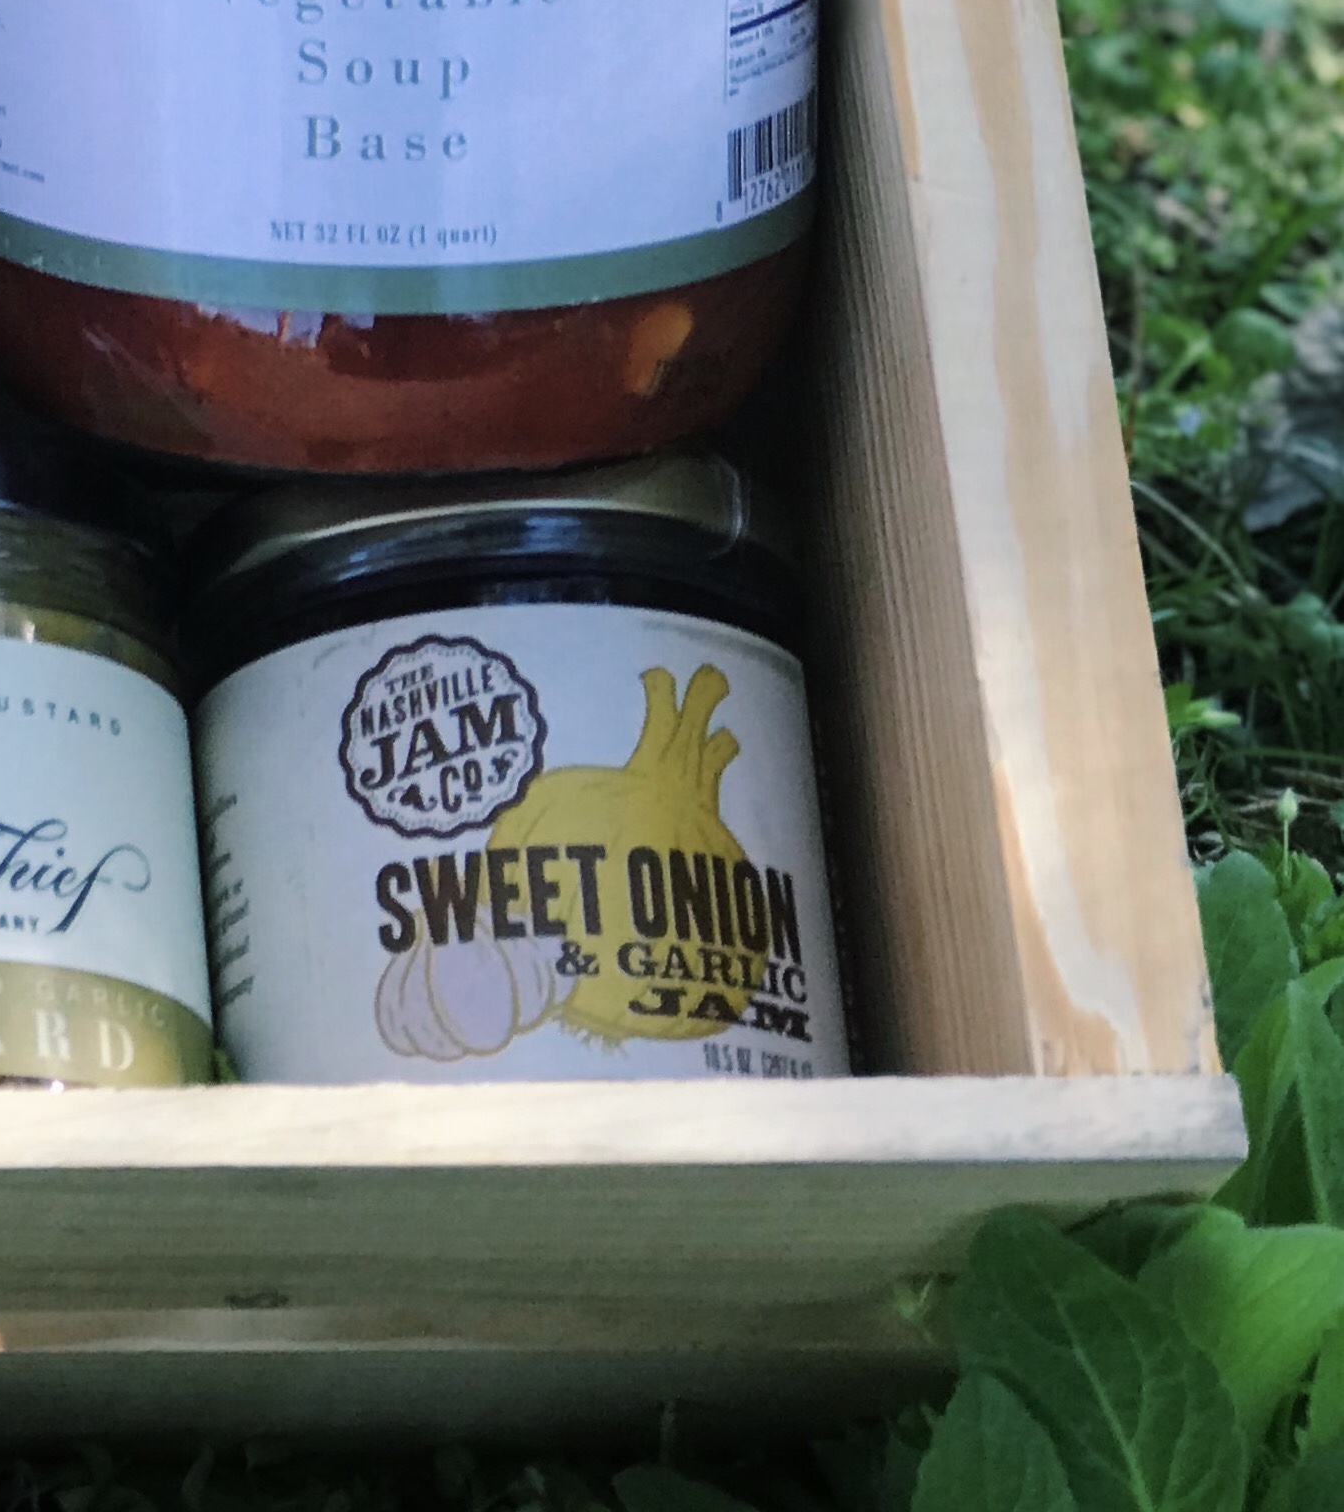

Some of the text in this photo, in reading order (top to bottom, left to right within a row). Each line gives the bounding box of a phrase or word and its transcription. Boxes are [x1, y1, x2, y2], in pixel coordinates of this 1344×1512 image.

[297, 39, 472, 100] Soup
[304, 114, 469, 163] Base
[270, 221, 304, 242] NET
[316, 223, 338, 244] 32
[377, 224, 400, 245] OZ
[437, 224, 497, 250] quart)
[360, 662, 495, 737] NASHVILLE
[385, 662, 434, 695] THE
[359, 693, 526, 789] JAM
[376, 845, 606, 953] SWEET
[628, 846, 802, 965] ONION
[555, 941, 807, 1003] & GARLIC
[36, 980, 167, 1028] GARLIC
[628, 987, 813, 1043] JAM
